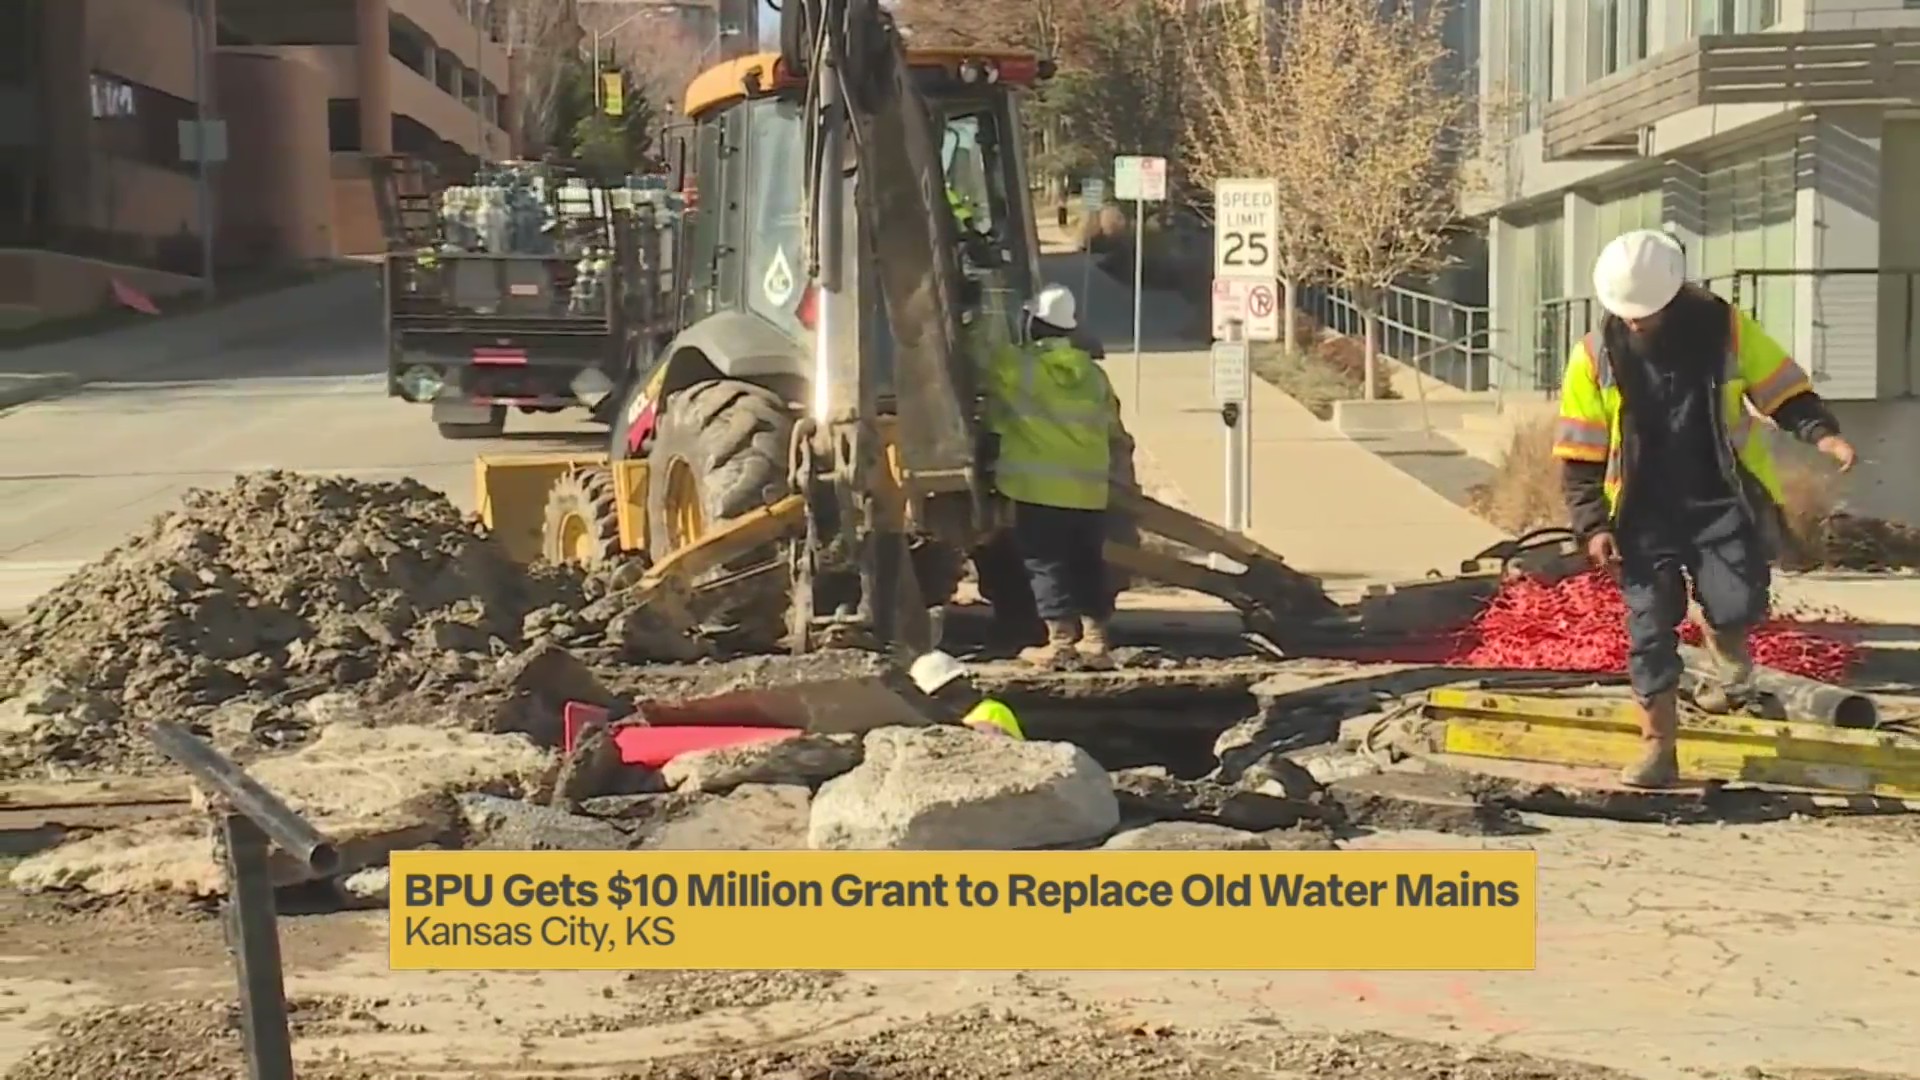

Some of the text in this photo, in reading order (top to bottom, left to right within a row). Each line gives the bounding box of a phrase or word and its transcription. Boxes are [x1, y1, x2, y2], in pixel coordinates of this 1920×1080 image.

[1222, 191, 1273, 207] SPEED
[1226, 212, 1266, 228] LIMIT
[1223, 232, 1269, 265] 25
